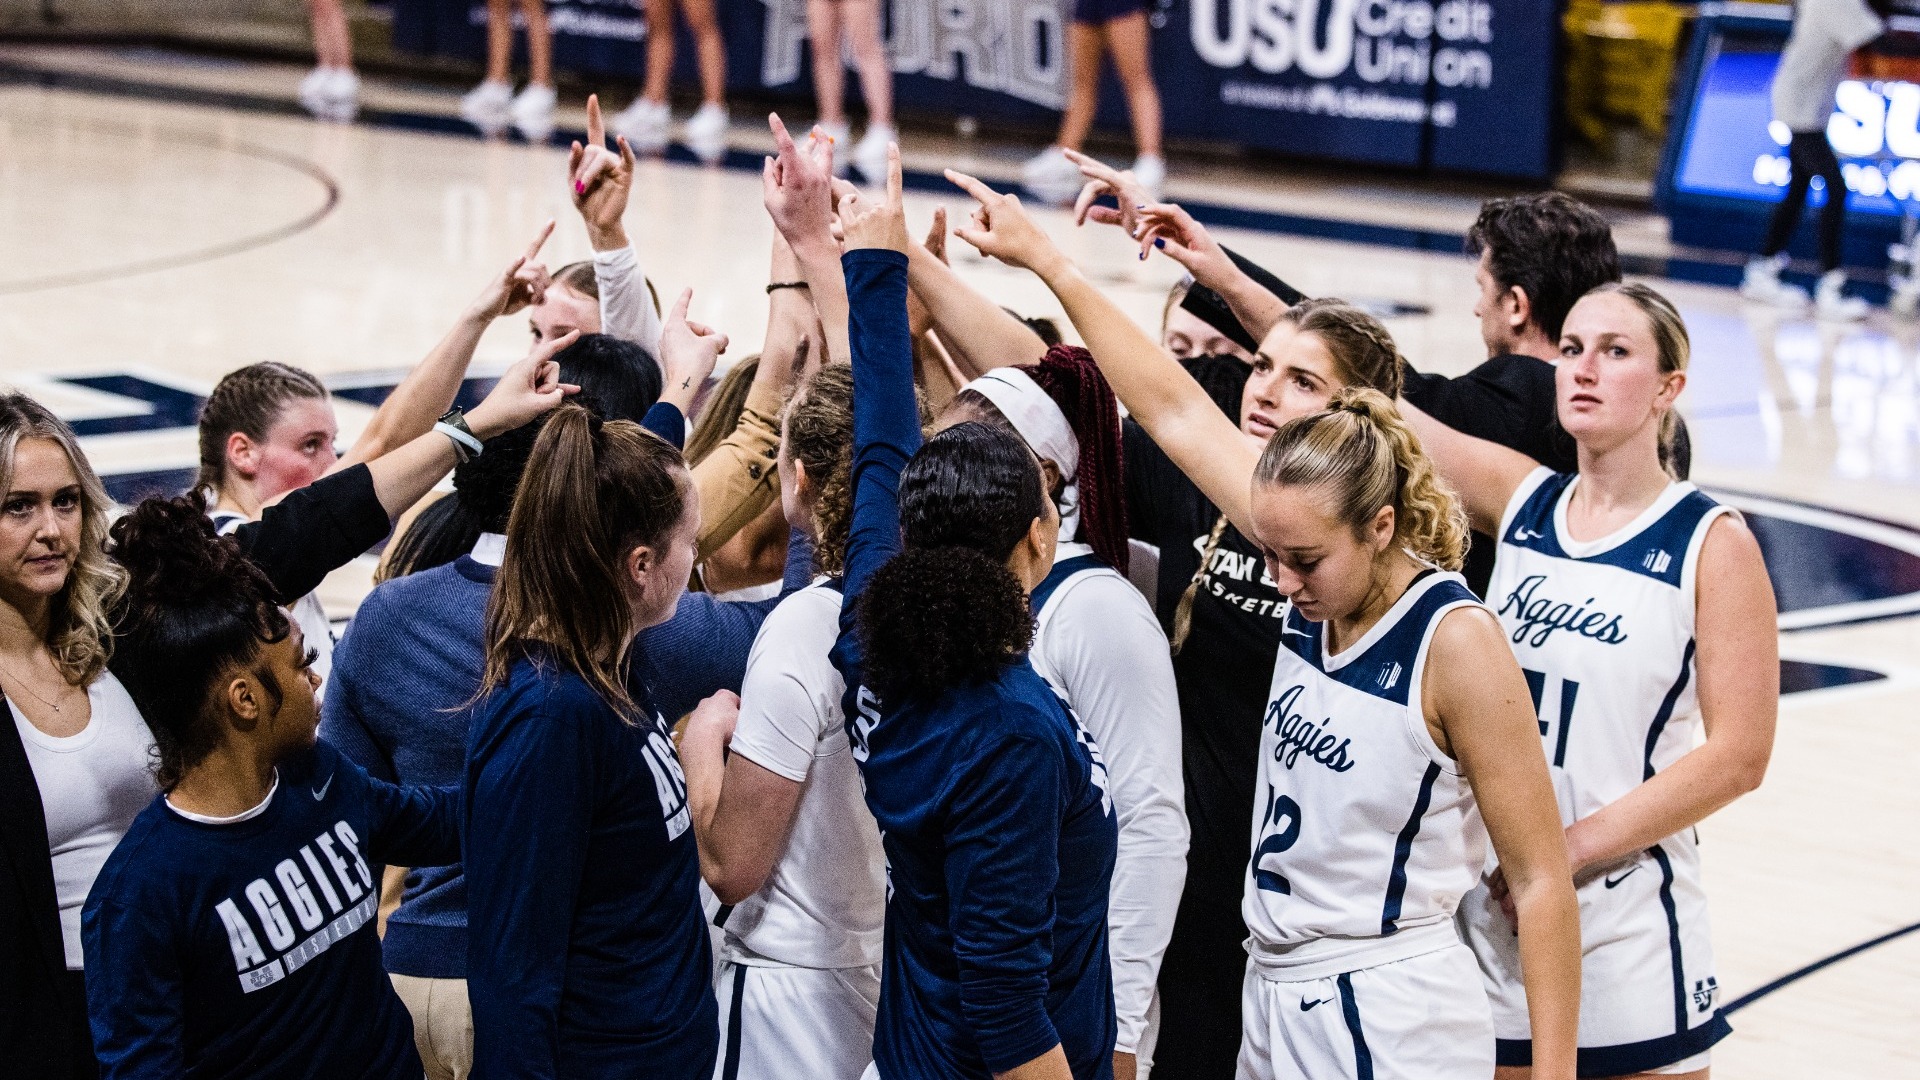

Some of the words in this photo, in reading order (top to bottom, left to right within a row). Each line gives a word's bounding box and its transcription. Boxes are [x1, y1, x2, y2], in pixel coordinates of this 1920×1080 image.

[1189, 0, 1353, 79] USU
[1353, 36, 1493, 88] Union
[1498, 575, 1628, 648] Aggies
[1264, 685, 1355, 772] Aggies
[1251, 782, 1302, 896] 12
[214, 820, 373, 972] AGGIES
